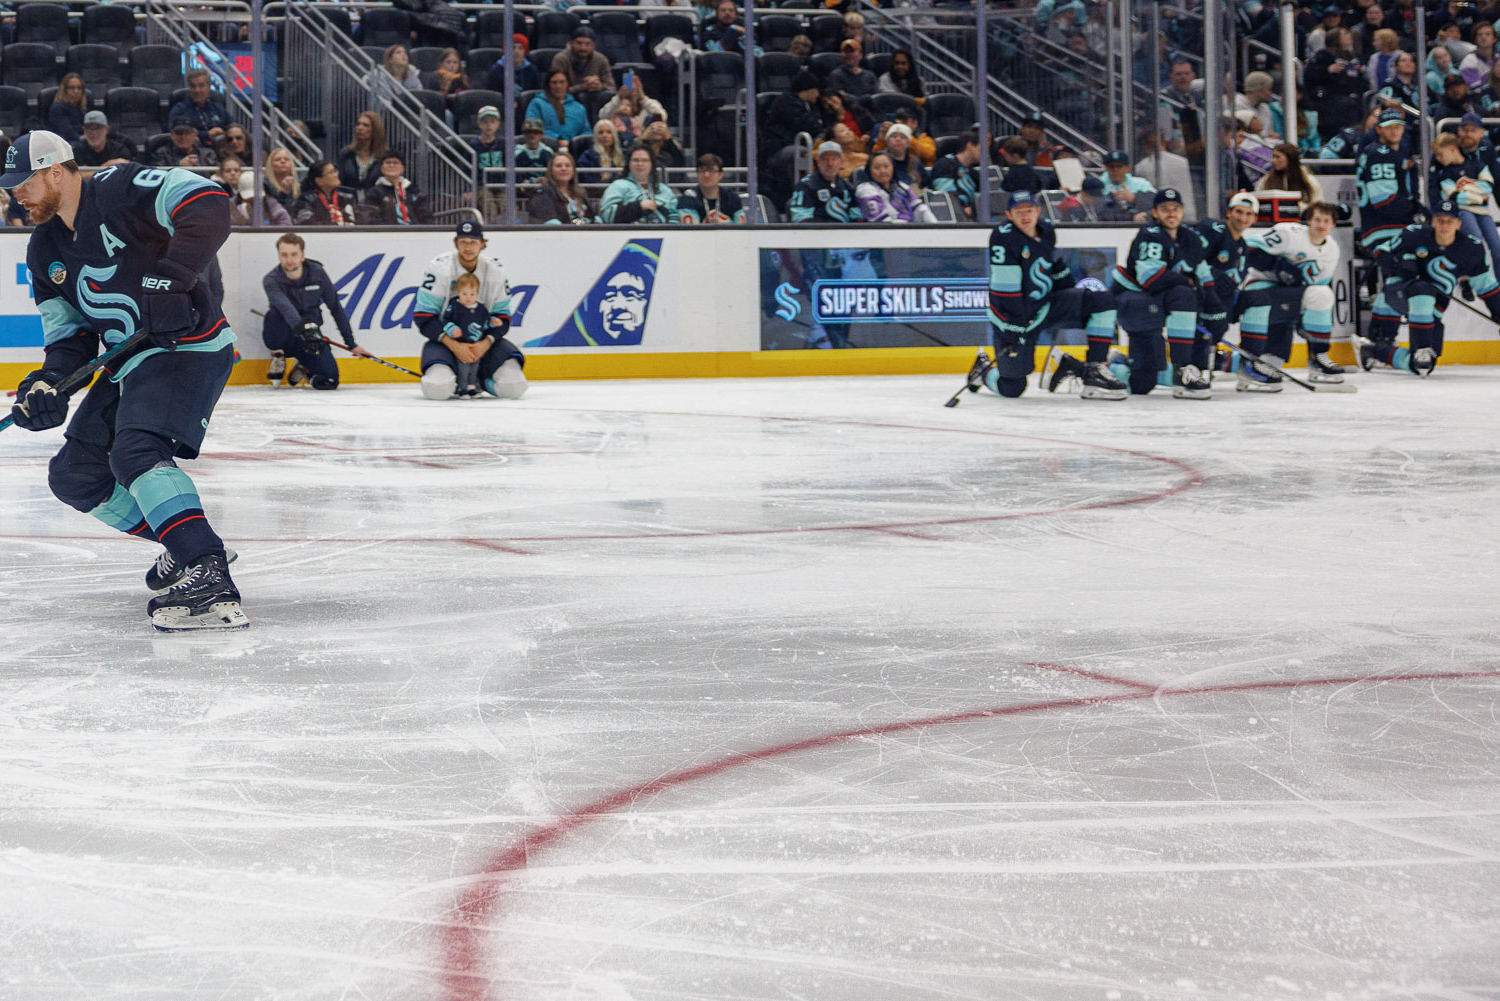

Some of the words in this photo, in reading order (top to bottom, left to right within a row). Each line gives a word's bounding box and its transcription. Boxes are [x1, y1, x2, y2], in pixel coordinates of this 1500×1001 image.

[1370, 163, 1396, 179] 95
[100, 223, 127, 258] A
[821, 287, 879, 314] SUPER
[881, 286, 943, 313] SKILLS
